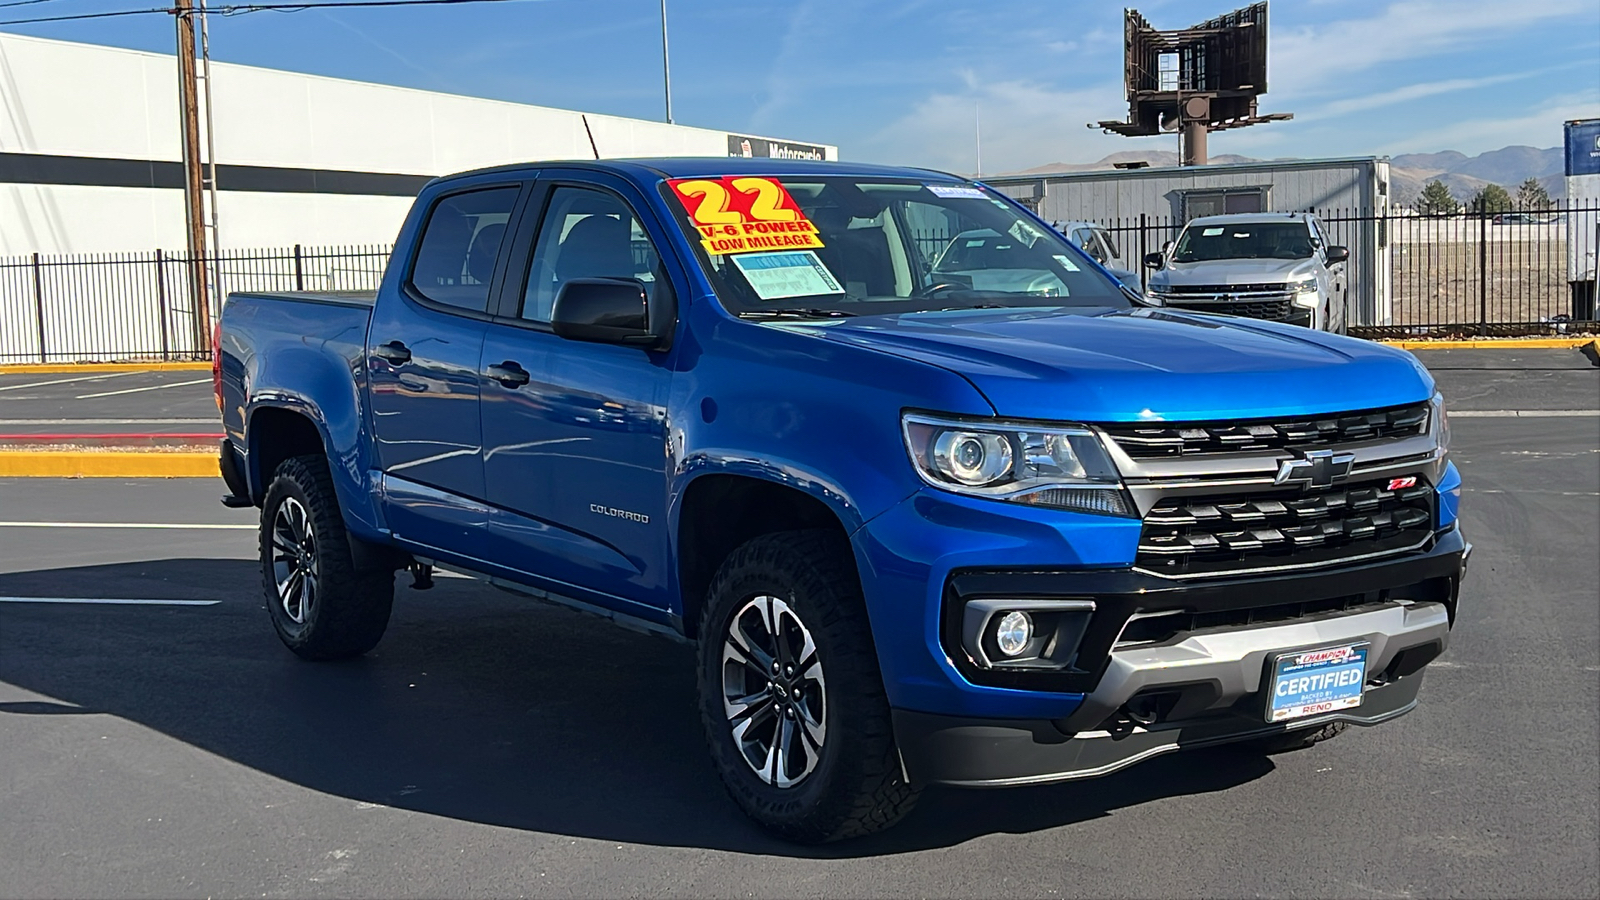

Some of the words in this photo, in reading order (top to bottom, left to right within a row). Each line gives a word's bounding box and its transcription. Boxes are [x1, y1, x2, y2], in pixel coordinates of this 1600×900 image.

[701, 224, 738, 238] V-6
[744, 221, 813, 235] POWER
[709, 238, 745, 251] LOW
[749, 234, 814, 249] MILEAGE
[590, 503, 650, 524] COLORADO
[1302, 648, 1348, 663] CHAMPION
[1276, 668, 1363, 697] CERTIFIED
[1302, 702, 1332, 714] RENO
